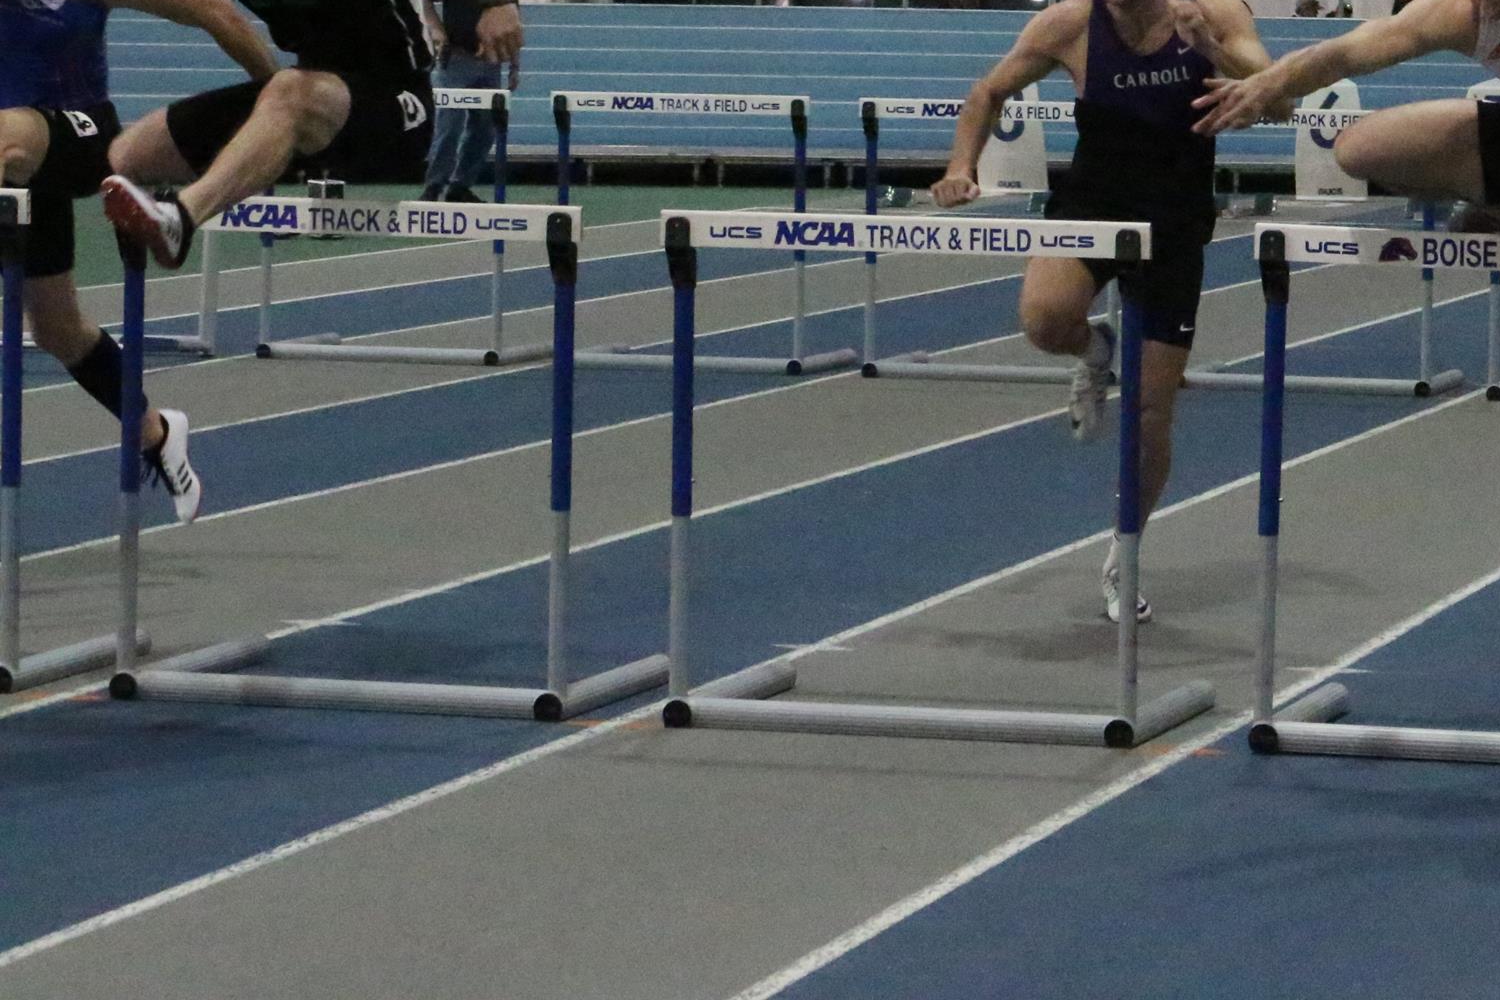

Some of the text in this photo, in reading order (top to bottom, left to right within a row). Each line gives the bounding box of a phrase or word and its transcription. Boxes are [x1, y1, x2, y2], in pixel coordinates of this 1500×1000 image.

[1113, 66, 1191, 89] CARROLL
[453, 96, 482, 104] UCS
[576, 99, 606, 107] UCS
[611, 96, 654, 110] NCAA
[659, 98, 700, 112] TRACK
[703, 100, 711, 112] &
[714, 100, 748, 113] FIELD
[886, 106, 916, 114] UCS
[1015, 107, 1024, 119] &
[1027, 107, 1061, 120] FIELD
[1287, 114, 1326, 127] RACK
[1329, 115, 1338, 127] &
[220, 203, 529, 235] NCAA TRACK & FIELD UCS
[709, 220, 1095, 252] UCS NCAA TRACK & FIELD UCS
[1304, 240, 1359, 256] UCS
[1422, 238, 1498, 268] BOISE
